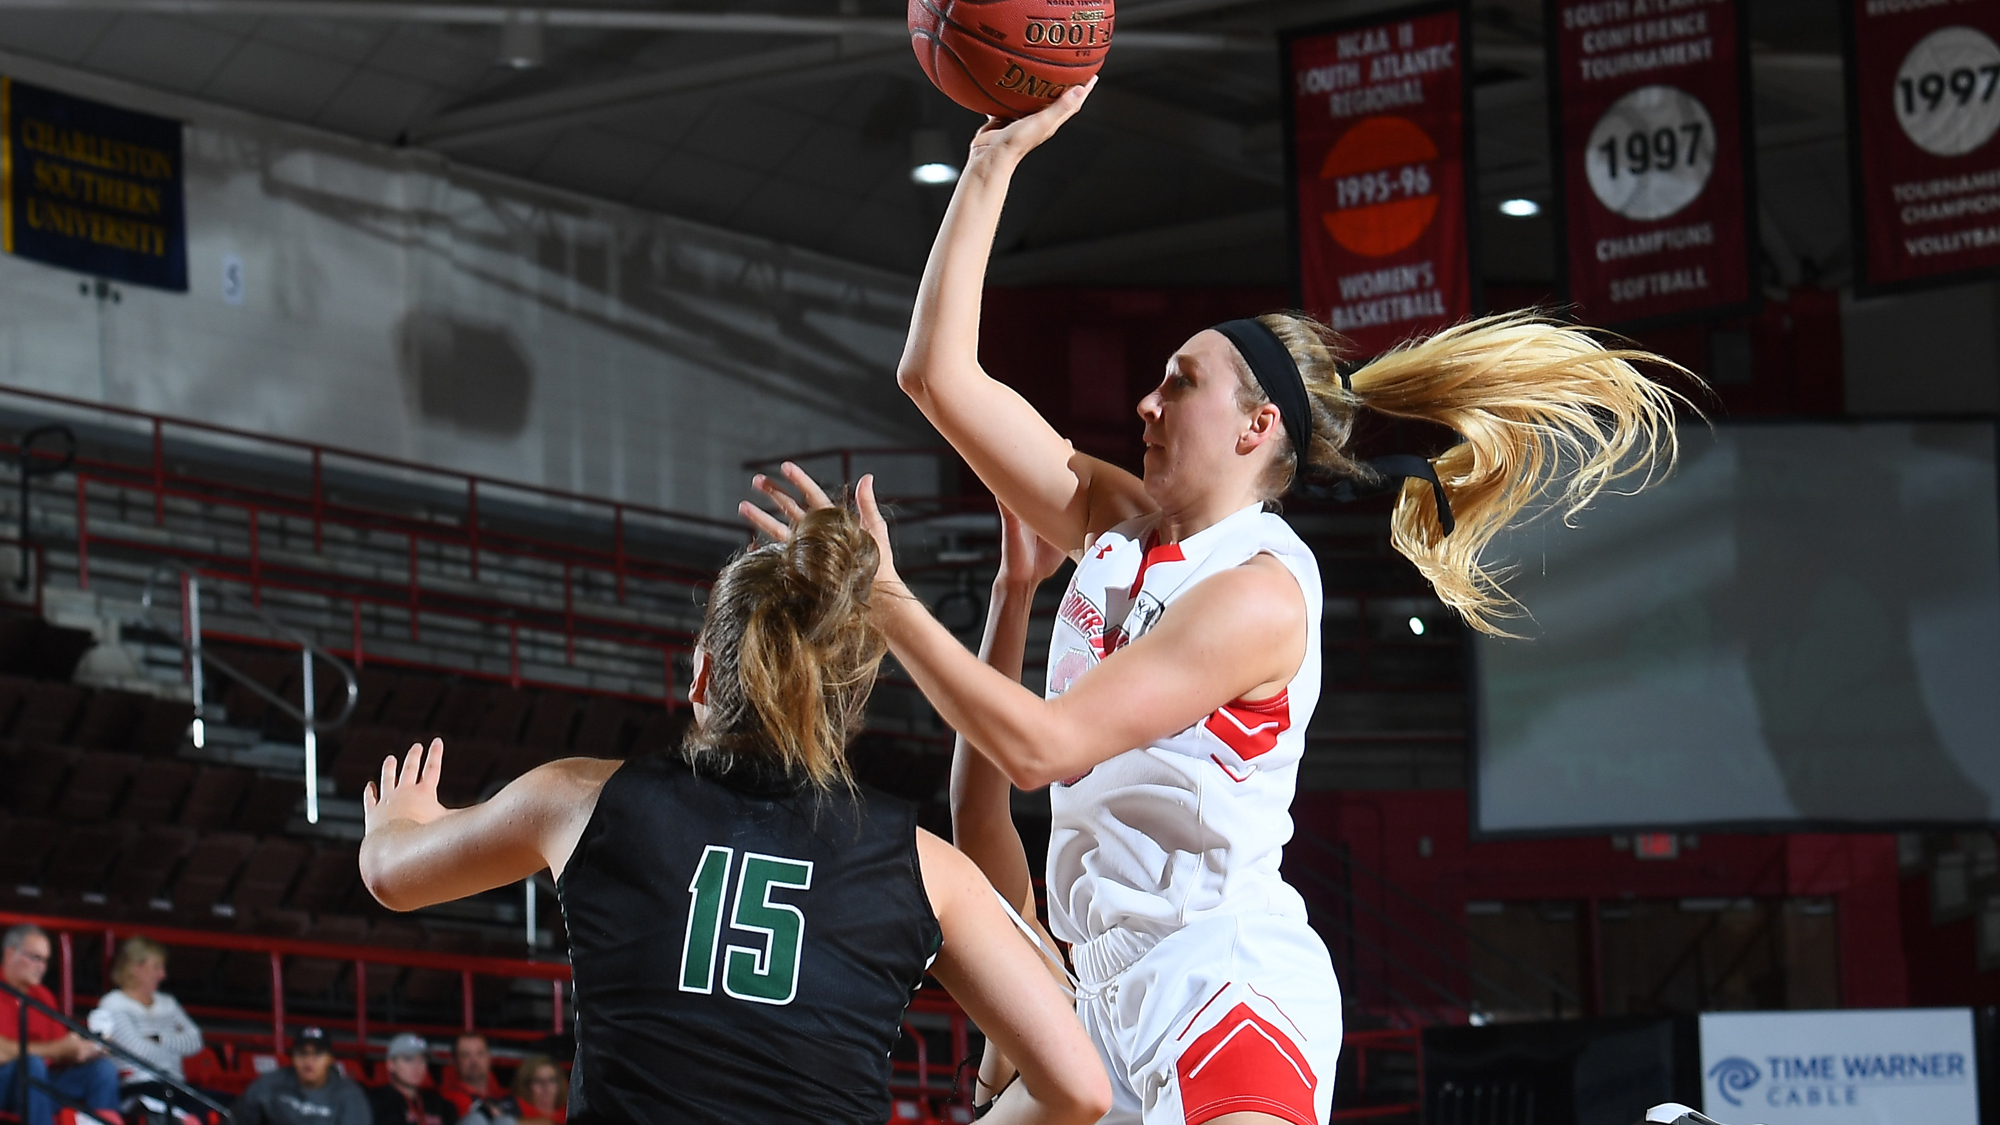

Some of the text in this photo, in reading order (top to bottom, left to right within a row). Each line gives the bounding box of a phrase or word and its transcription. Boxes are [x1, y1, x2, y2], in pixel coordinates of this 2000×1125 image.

[1337, 27, 1390, 59] NCAA
[1582, 11, 1707, 54] CONFERENCE
[1370, 42, 1455, 82] ATLANTIC
[1580, 37, 1713, 81] TOURNAMENT
[997, 63, 1070, 100] DING
[1330, 79, 1424, 118] REGIONAL
[1900, 63, 2000, 116] 1997
[22, 117, 173, 180] CHARLESTON
[1599, 122, 1704, 180] 1997
[33, 158, 161, 213] SOUTHERN
[1336, 166, 1431, 208] 1995-96
[1892, 169, 2000, 203] TOURNAME
[26, 192, 165, 256] UNIVERSITY
[1596, 222, 1713, 262] CHAMPIONS
[1904, 225, 2000, 258] VOLLEYBA
[1338, 262, 1434, 301] WOMEN'S
[1610, 266, 1707, 302] SOFTBALL
[1331, 290, 1445, 332] BASKETBALL
[678, 844, 814, 1006] 15
[1765, 1053, 1965, 1080] TIME WARNER
[1766, 1085, 1858, 1107] CABLE
